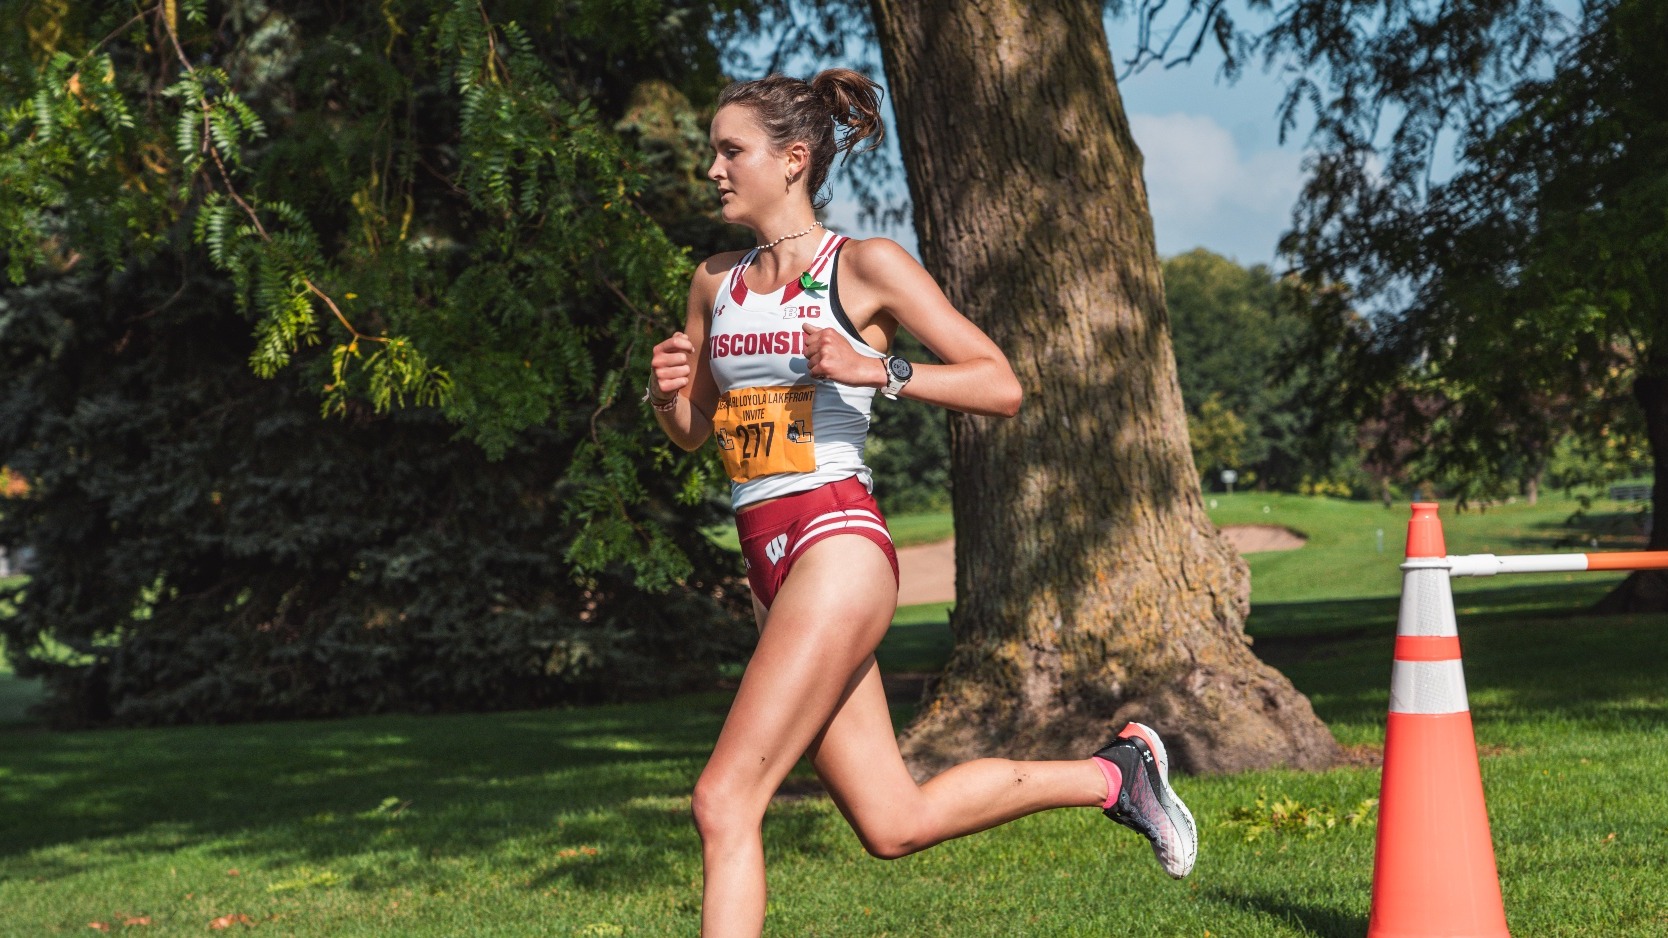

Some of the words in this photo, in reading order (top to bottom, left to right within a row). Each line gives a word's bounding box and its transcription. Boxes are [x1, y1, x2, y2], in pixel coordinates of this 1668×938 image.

[739, 393, 767, 407] LOYOLA
[767, 390, 814, 404] LAKEFRONT
[742, 408, 765, 422] INVITE
[735, 421, 775, 459] 277
[764, 532, 789, 566] W
